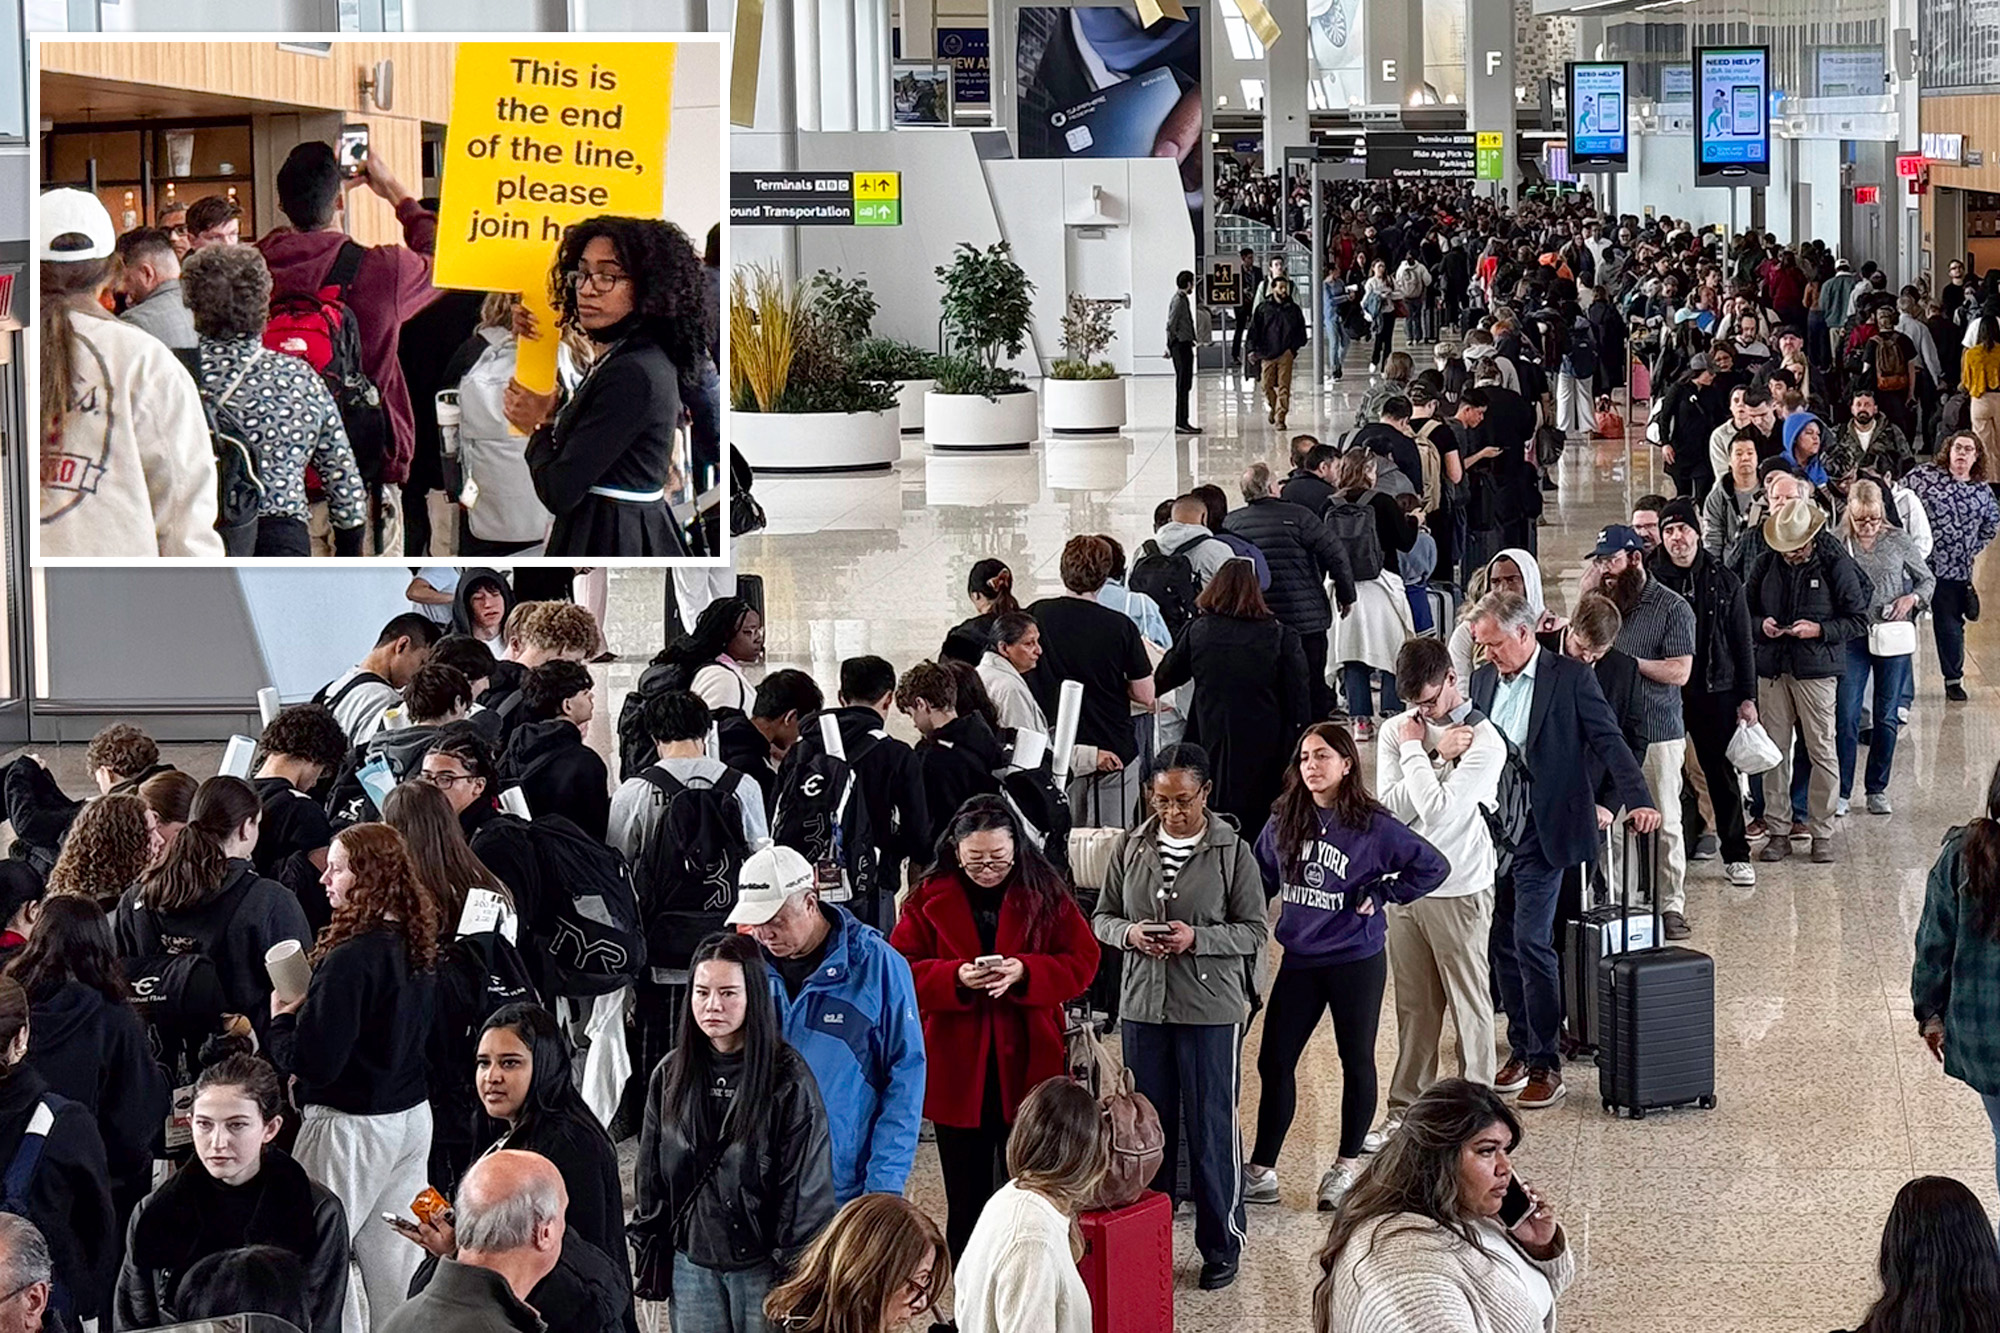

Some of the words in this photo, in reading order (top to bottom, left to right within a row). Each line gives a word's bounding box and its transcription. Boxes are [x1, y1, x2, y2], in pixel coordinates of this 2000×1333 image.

[510, 58, 578, 88] This
[590, 63, 617, 90] is
[1382, 60, 1396, 81] E
[1486, 51, 1501, 76] F
[497, 97, 549, 124] the
[560, 105, 623, 130] end
[467, 134, 501, 159] of
[511, 136, 563, 164] the
[575, 140, 643, 175] line,
[754, 179, 812, 191] Terminals
[1422, 169, 1475, 177] Transportation
[496, 174, 608, 206] please
[467, 210, 529, 242] join
[763, 205, 850, 219] Transportation
[1211, 289, 1235, 301] Exit
[1317, 840, 1349, 880] YORK
[1283, 882, 1344, 911] UNIVERSITY
